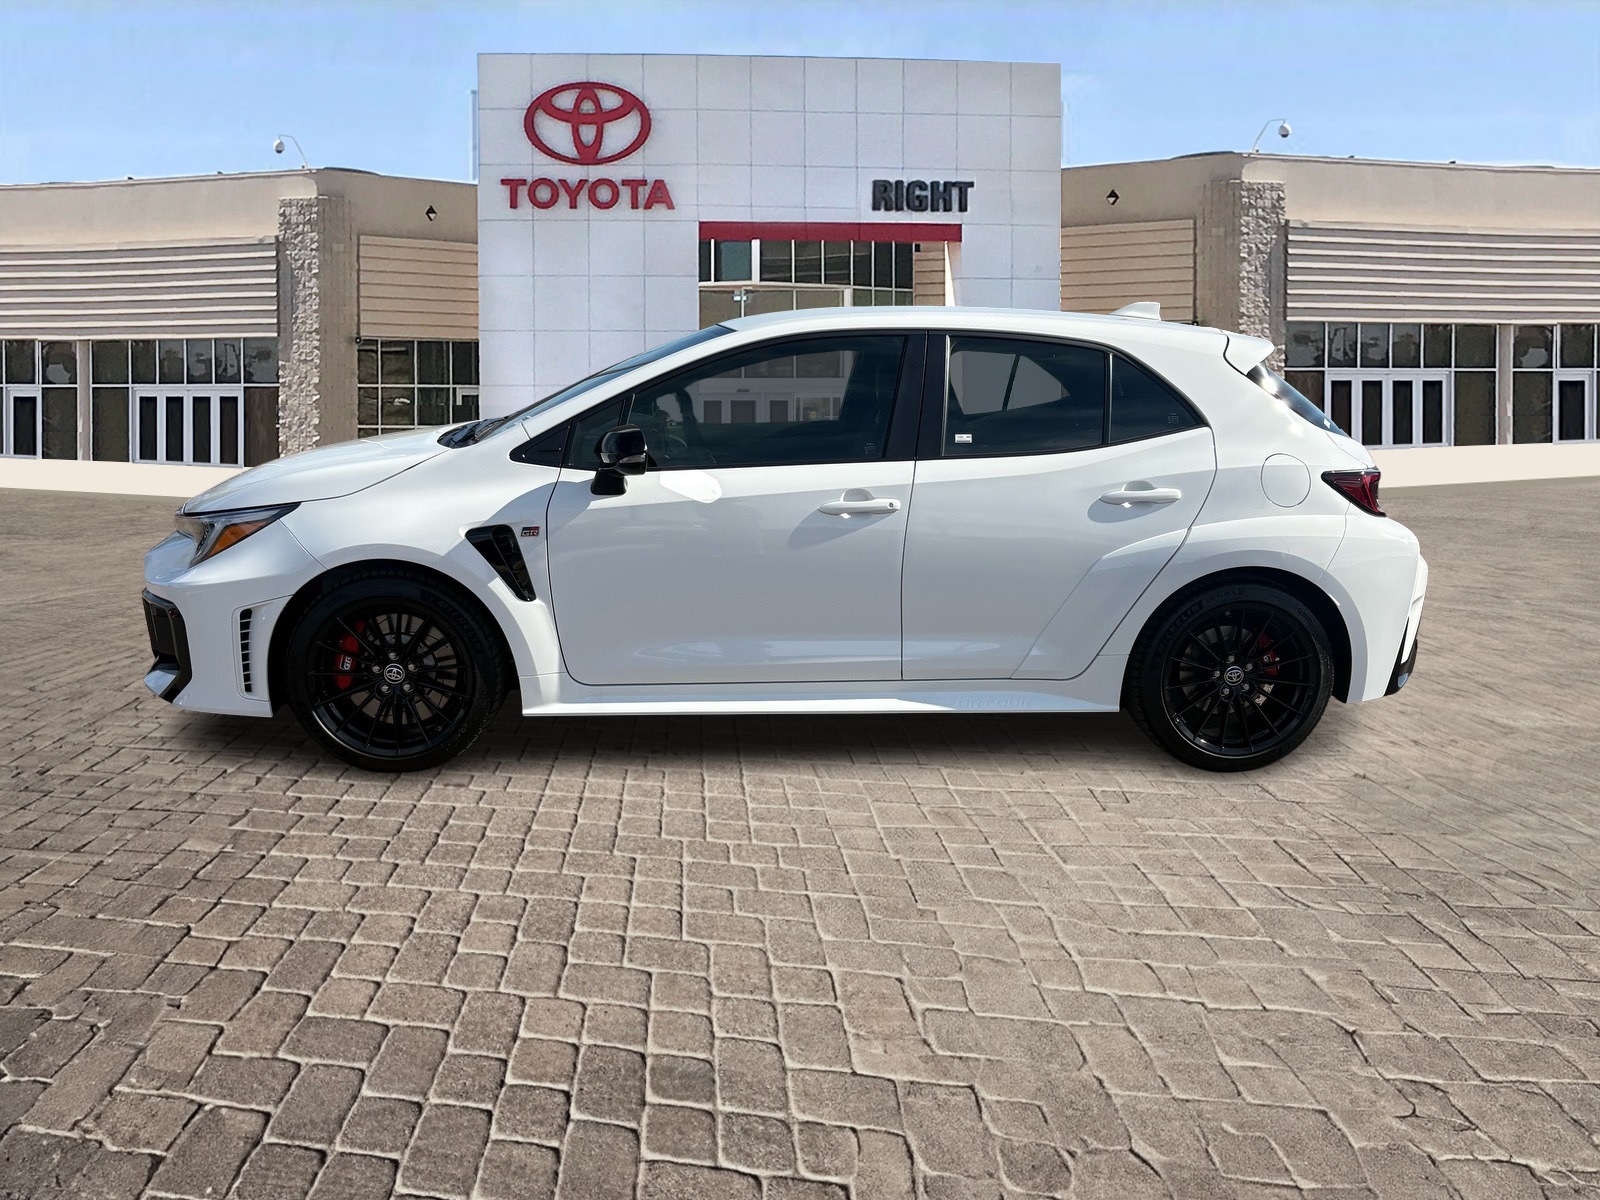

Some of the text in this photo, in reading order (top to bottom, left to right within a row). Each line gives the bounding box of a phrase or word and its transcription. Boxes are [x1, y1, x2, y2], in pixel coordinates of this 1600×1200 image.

[500, 178, 674, 210] TOYOTA
[872, 180, 975, 212] RIGHT
[521, 528, 540, 537] GR
